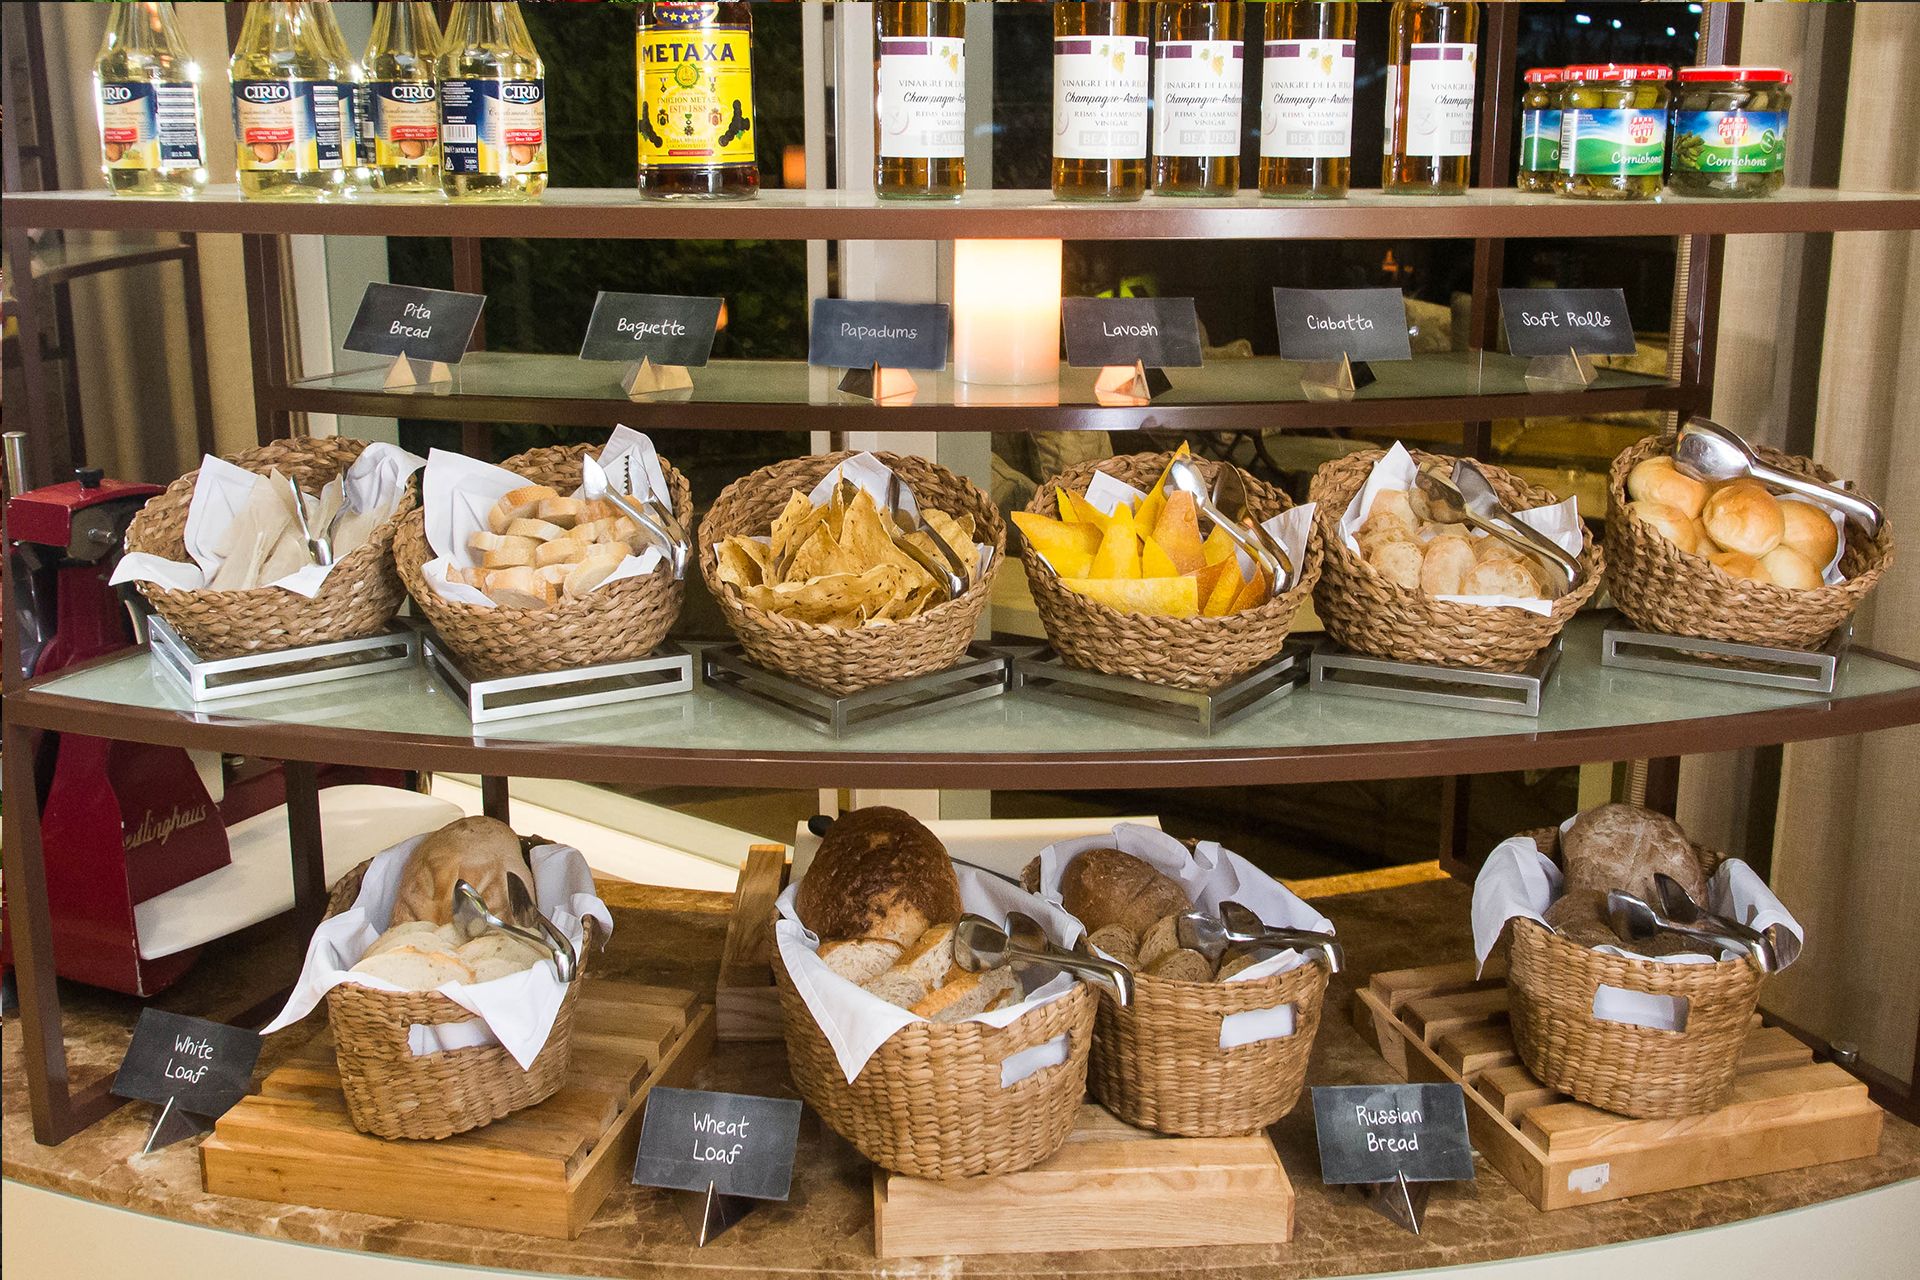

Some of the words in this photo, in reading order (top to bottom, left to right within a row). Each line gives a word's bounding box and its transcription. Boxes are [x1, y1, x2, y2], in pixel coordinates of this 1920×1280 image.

[642, 43, 735, 62] METAXA
[245, 86, 289, 99] CIRIO
[392, 86, 435, 99] CIRIO
[502, 85, 540, 99] CIRIO
[1611, 151, 1661, 164] Cornichons
[1706, 153, 1767, 167] Cornichons
[403, 302, 431, 320] Pita
[1521, 311, 1560, 327] Soft
[1566, 311, 1612, 327] Rolls
[389, 320, 432, 339] Bread
[617, 317, 686, 341] Baguette
[840, 322, 918, 340] Papadums
[1102, 321, 1159, 337] Lavosh
[1306, 314, 1374, 331] Ciabatta
[174, 1033, 214, 1060] White
[164, 1057, 209, 1084] Loaf
[1355, 1105, 1423, 1127] Russian
[693, 1112, 750, 1139] Wheat
[1366, 1132, 1419, 1153] Bread
[693, 1139, 743, 1165] Loaf
